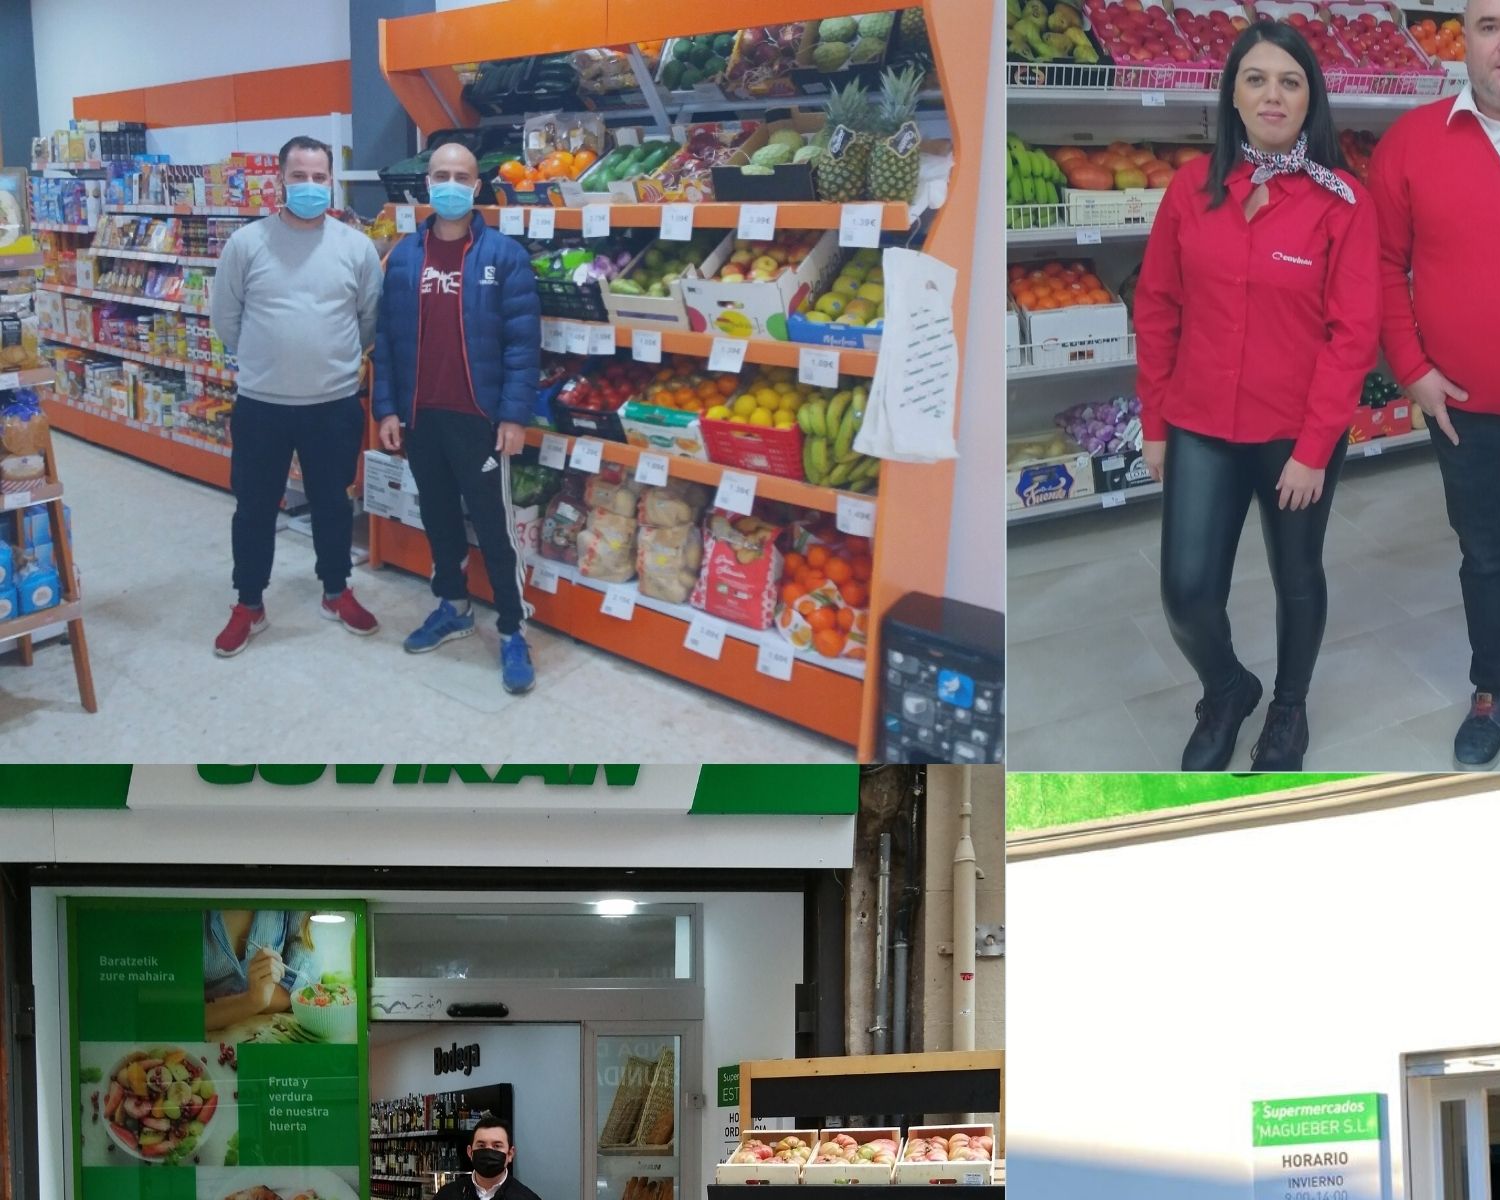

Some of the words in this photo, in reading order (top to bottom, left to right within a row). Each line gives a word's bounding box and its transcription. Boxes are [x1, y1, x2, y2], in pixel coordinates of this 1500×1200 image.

[99, 955, 158, 966] Baratzetik
[99, 972, 125, 981] zure
[128, 969, 175, 981] mahaira
[434, 1042, 480, 1077] Bodega
[269, 1076, 299, 1087] Fruta
[302, 1079, 309, 1088] y
[269, 1092, 313, 1102] verdura
[269, 1106, 283, 1116] de
[286, 1107, 329, 1116] nuestra
[1263, 1100, 1365, 1121] Supermercados
[269, 1121, 307, 1131] huerta
[1260, 1119, 1339, 1138] MAGUEBER
[1282, 1152, 1348, 1168] HORARIO
[1288, 1175, 1343, 1189] INVIERNO
